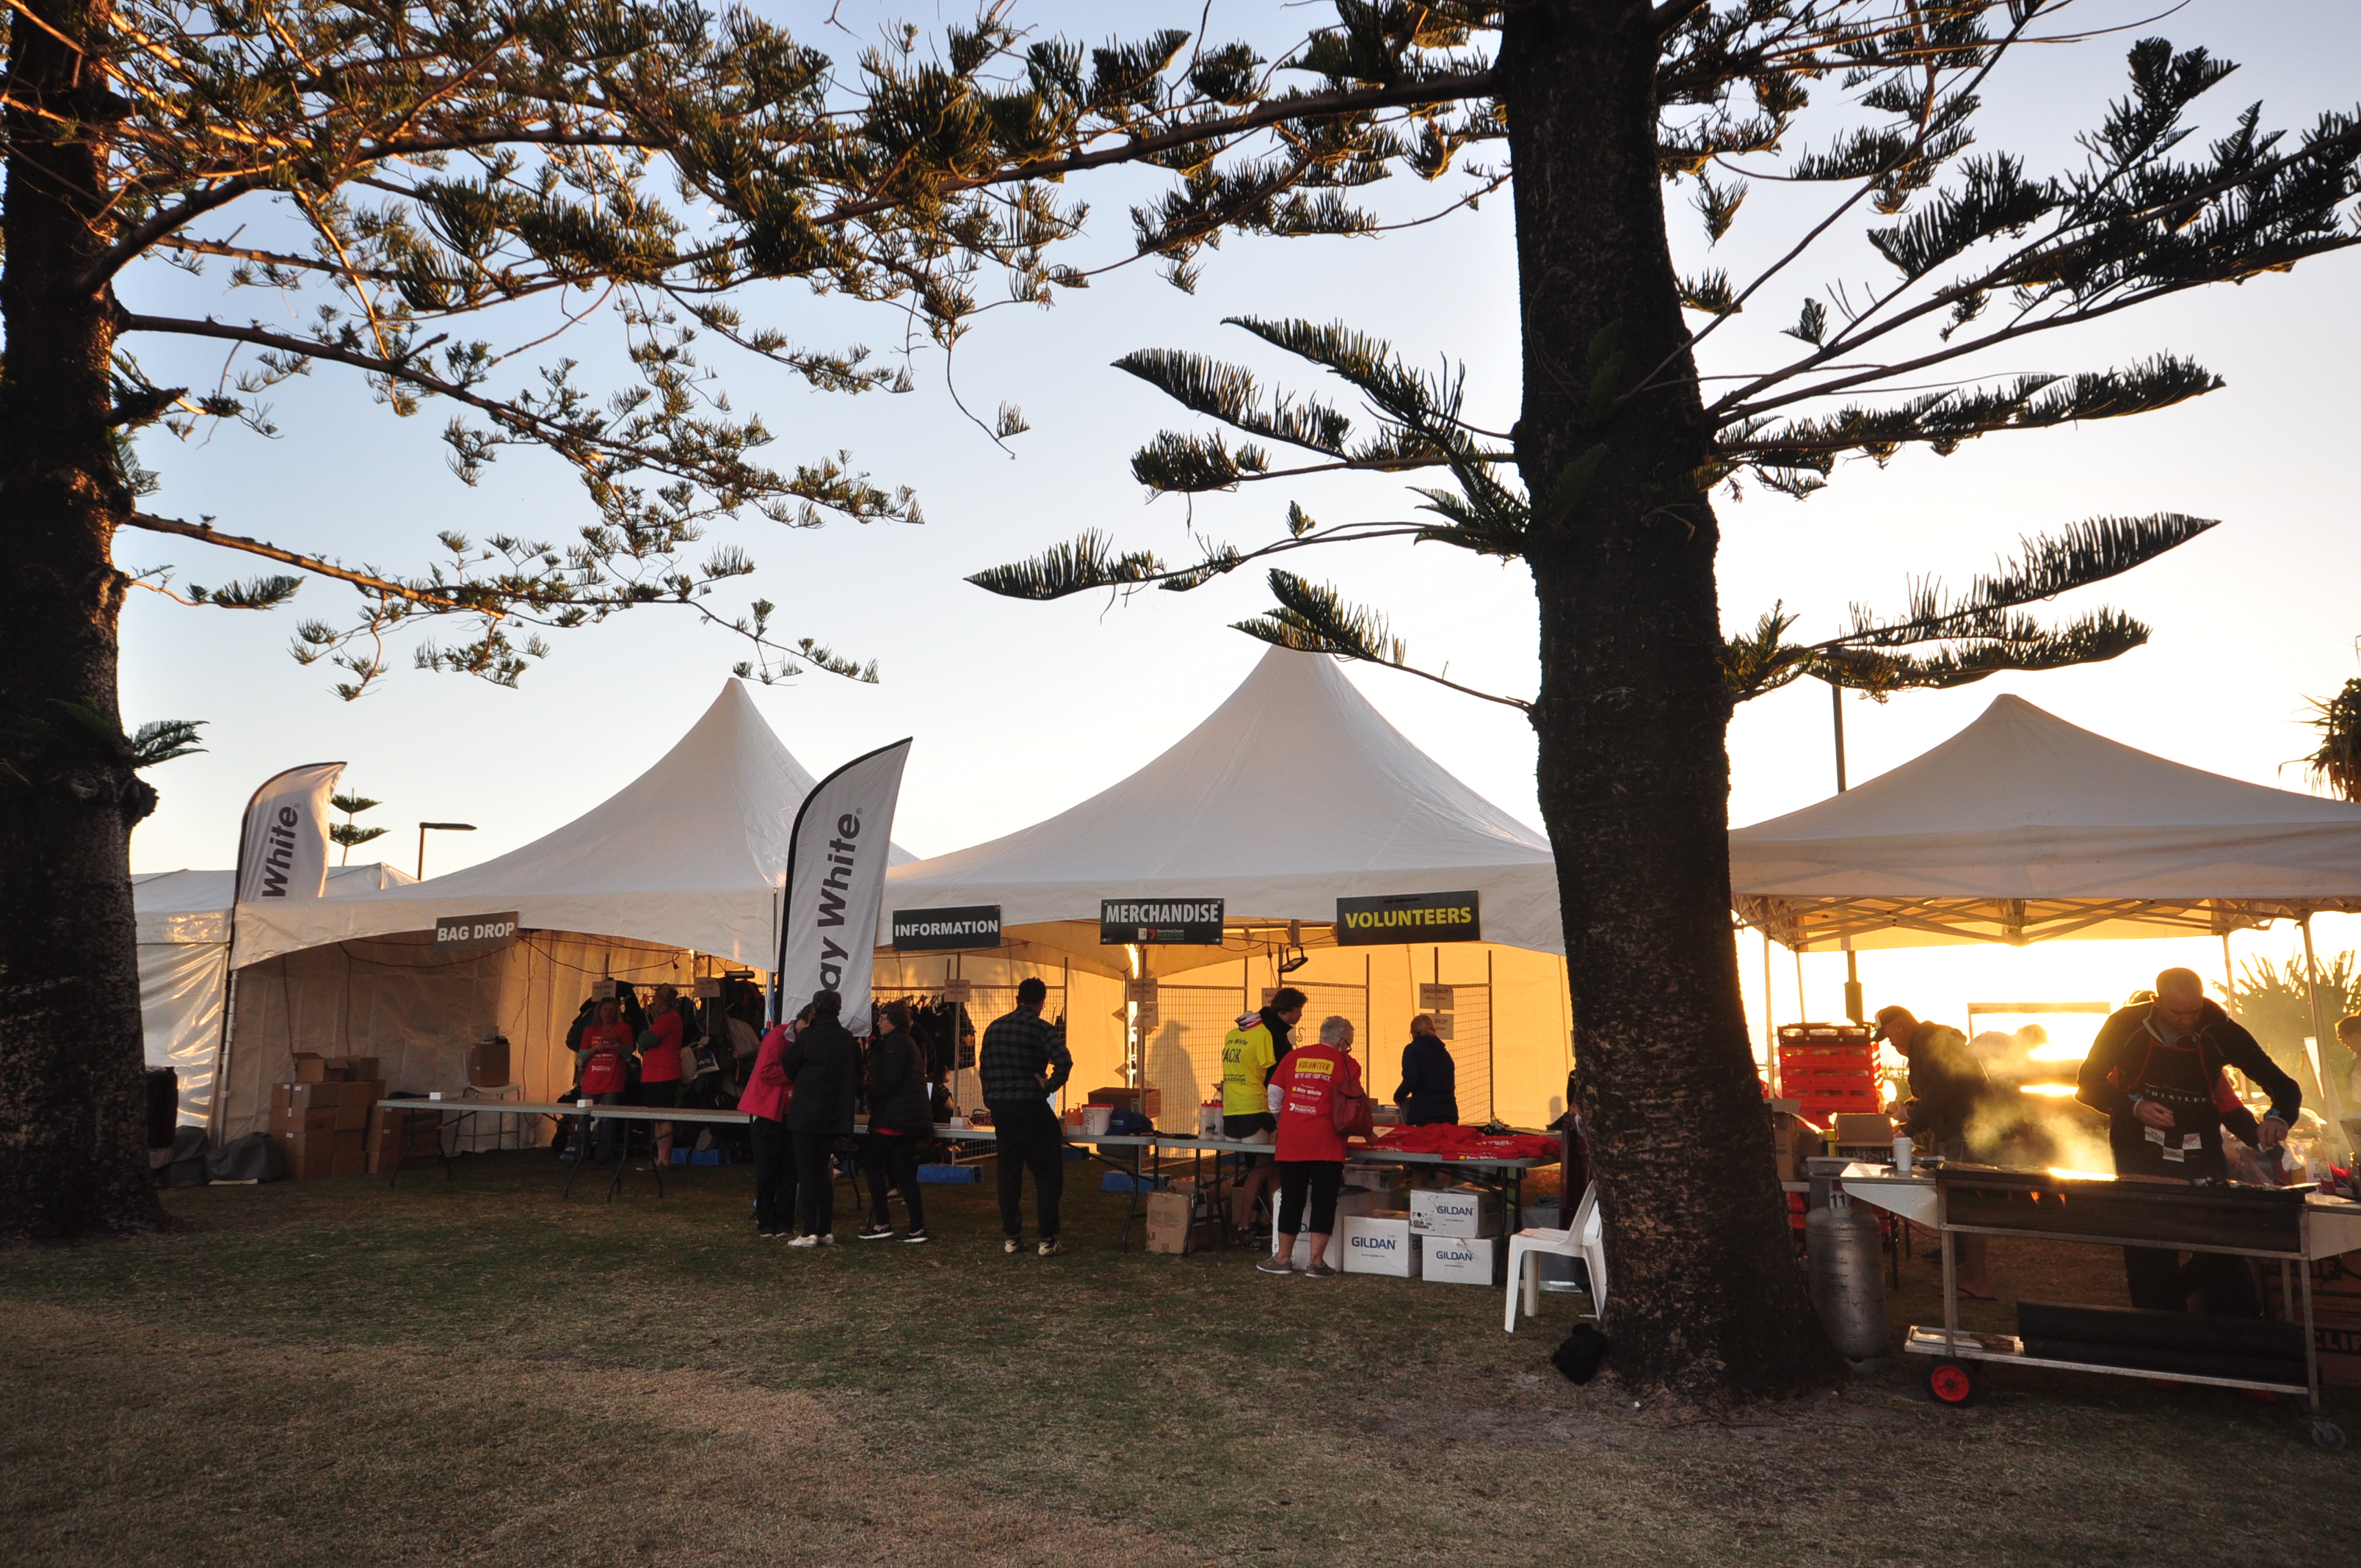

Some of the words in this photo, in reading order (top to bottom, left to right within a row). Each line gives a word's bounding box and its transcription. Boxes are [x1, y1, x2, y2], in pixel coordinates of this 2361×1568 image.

[261, 806, 298, 897] White
[817, 813, 860, 927] White
[1106, 904, 1219, 923] MERCHANDISE
[1345, 907, 1472, 929] VOLUNTEERS
[437, 926, 470, 942] BAG
[474, 922, 515, 939] DROP
[895, 920, 998, 937] INFORMATION
[819, 935, 849, 991] ay
[1298, 1061, 1331, 1071] VOLUNTEER
[1437, 1205, 1473, 1216] GILDAN
[1352, 1236, 1396, 1250] GILDAN
[1436, 1251, 1473, 1261] GILDAN
